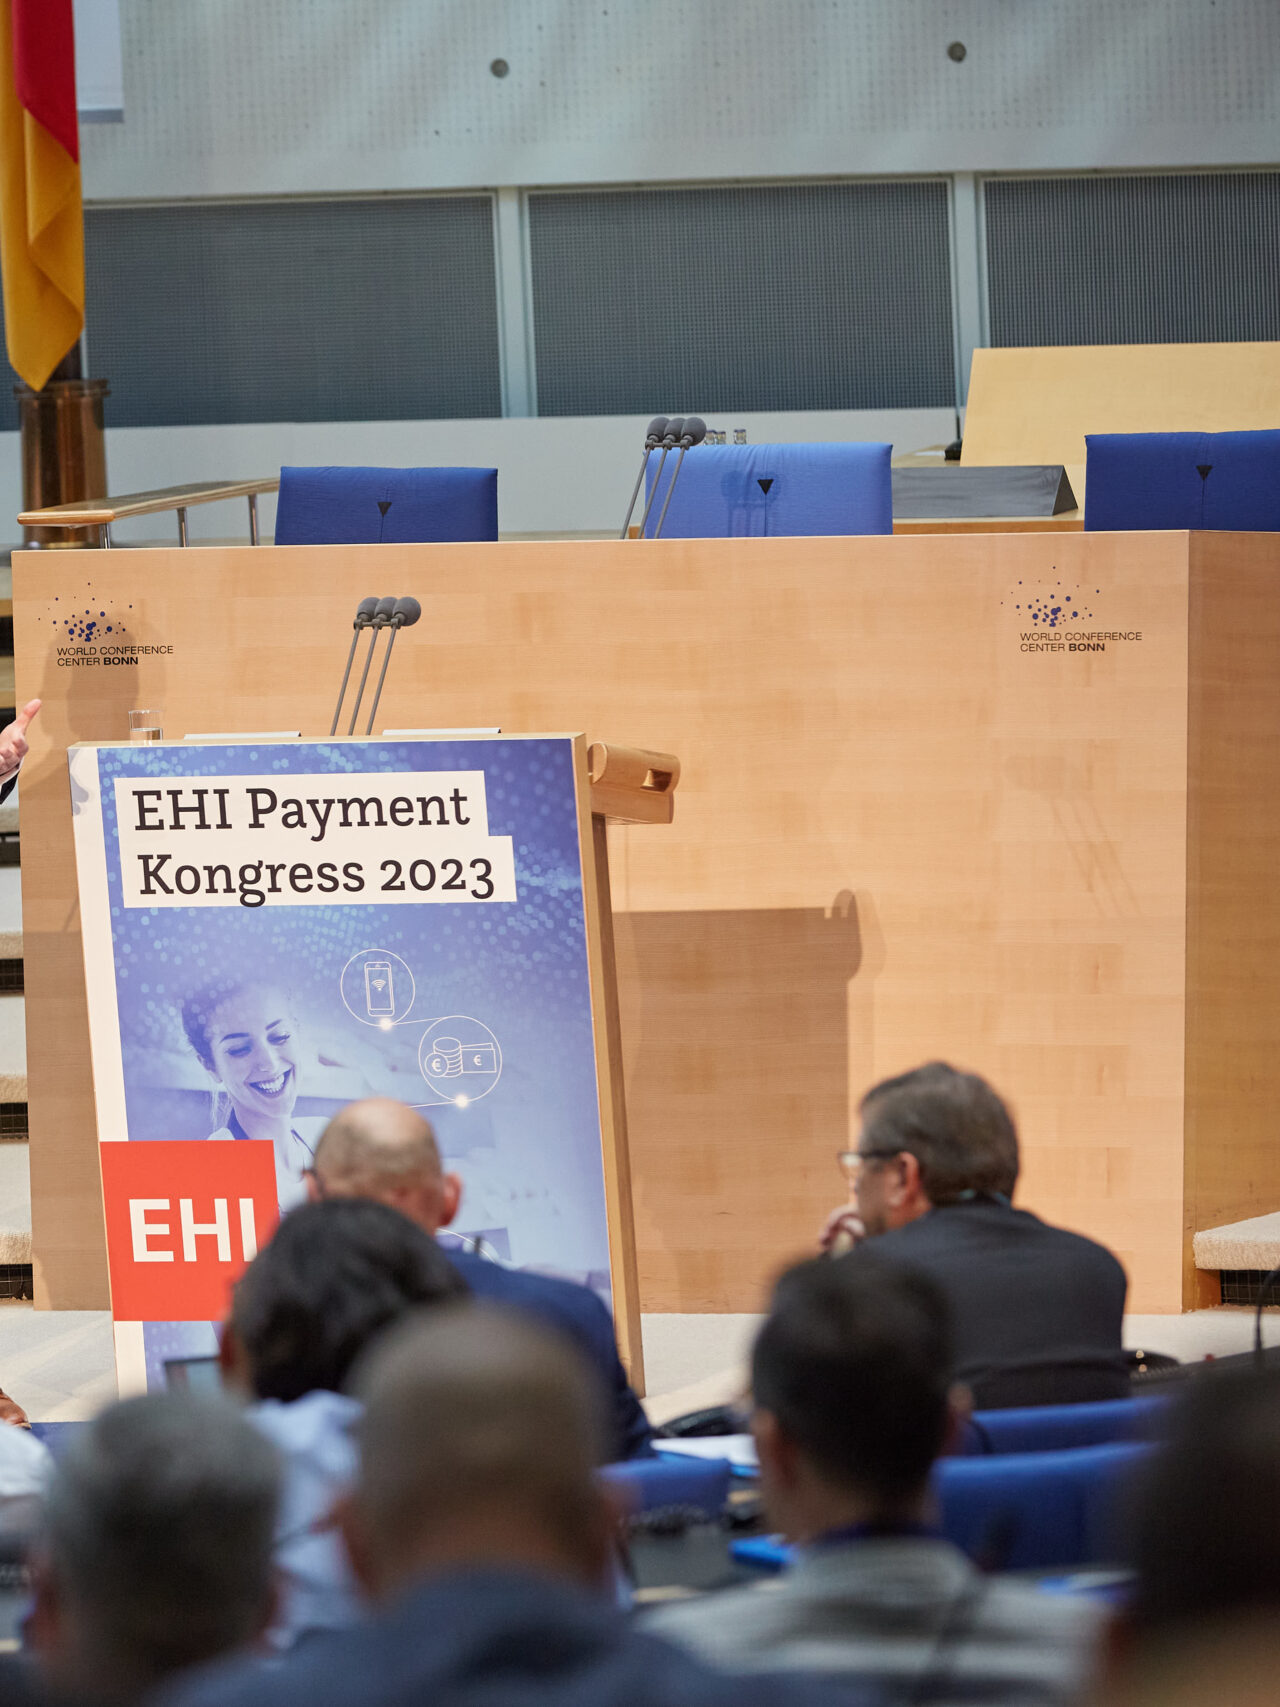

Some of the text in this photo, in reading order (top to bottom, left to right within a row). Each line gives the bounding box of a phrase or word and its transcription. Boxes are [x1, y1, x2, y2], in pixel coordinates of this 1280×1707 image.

[1019, 631, 1143, 641] WORLD CONFERENCE
[56, 645, 174, 656] WORLD CONFERENCE
[1019, 642, 1105, 652] CENTER BONN
[56, 656, 139, 667] CENTER BONN
[131, 787, 471, 842] EHI Payment
[137, 853, 495, 908] Kongress 2023
[128, 1197, 258, 1262] EHI
